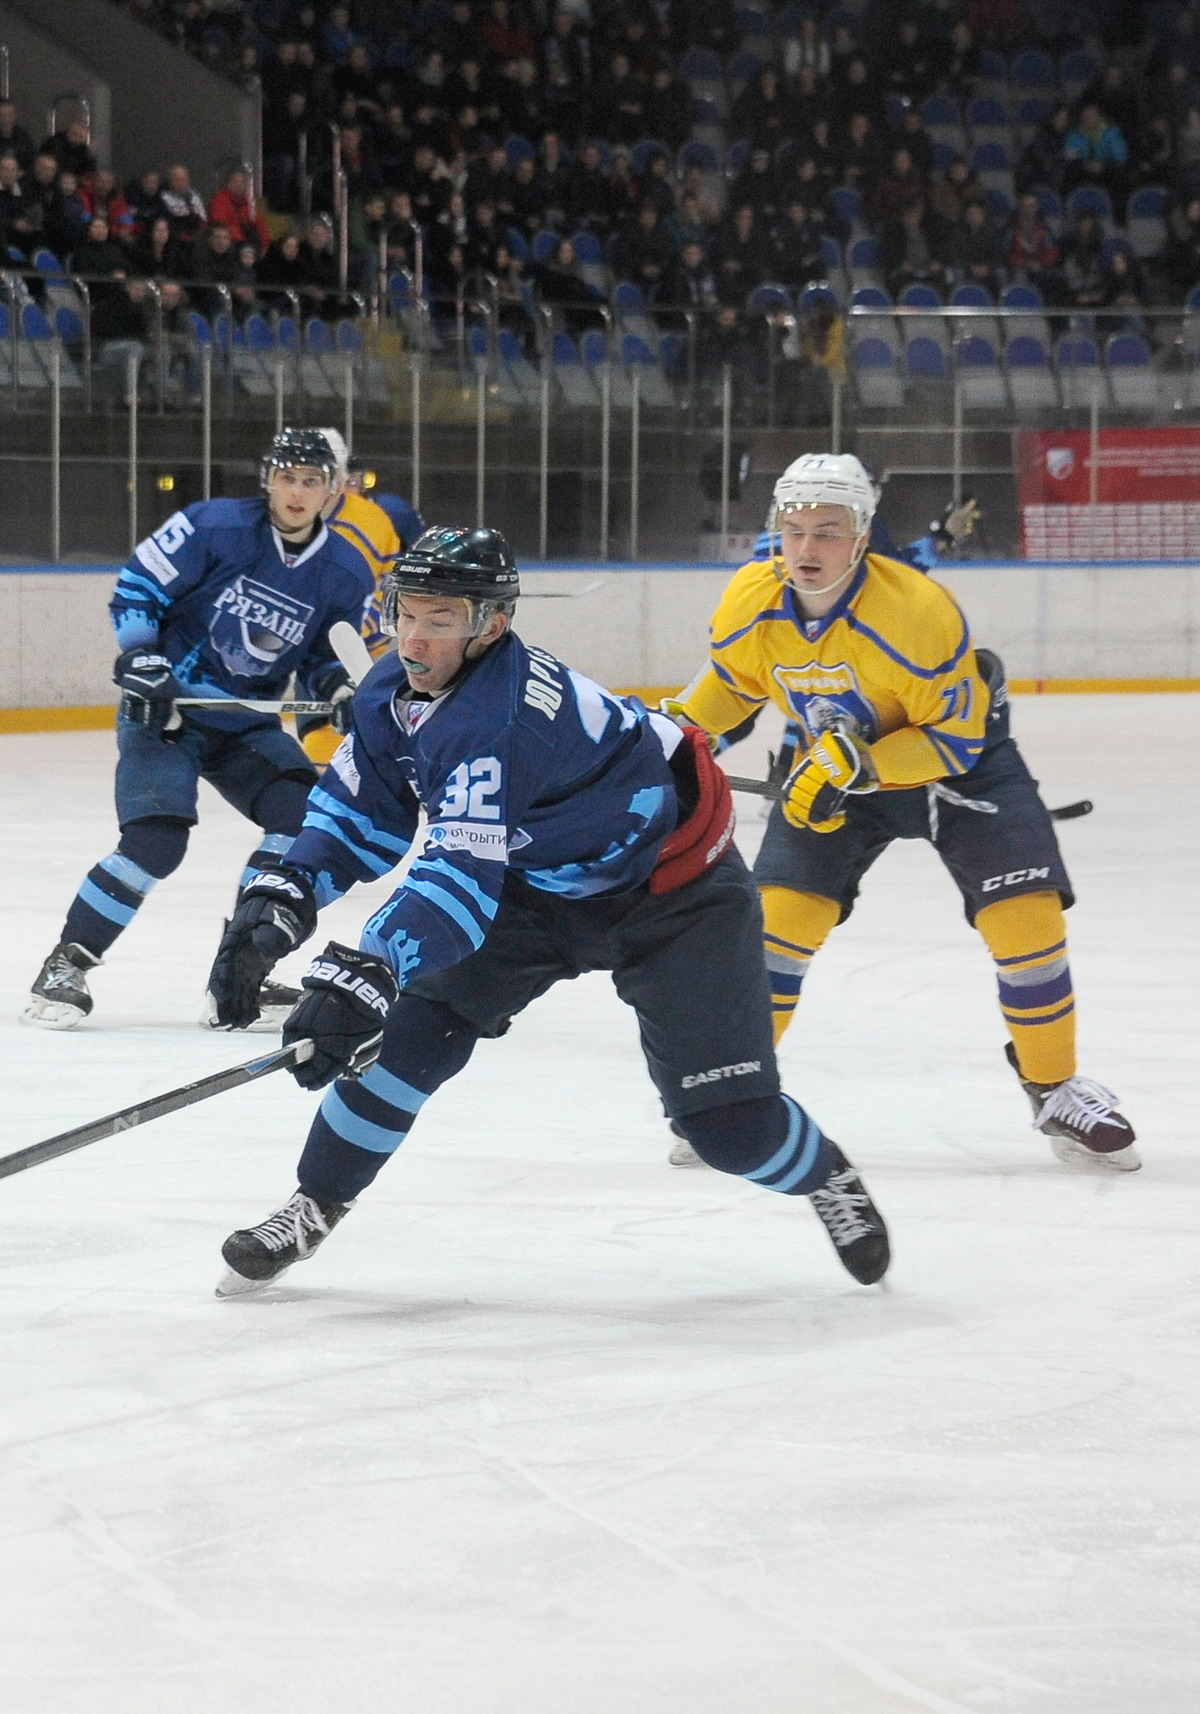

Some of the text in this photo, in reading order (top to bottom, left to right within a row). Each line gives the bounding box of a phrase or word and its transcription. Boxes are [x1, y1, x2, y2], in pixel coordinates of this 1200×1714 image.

[399, 564, 432, 574] BAUER
[213, 587, 308, 646] РЯЗАНЬ
[439, 756, 502, 821] 32
[982, 866, 1050, 893] CCM
[304, 959, 390, 1019] BAUER
[681, 1060, 762, 1090] EASTON
